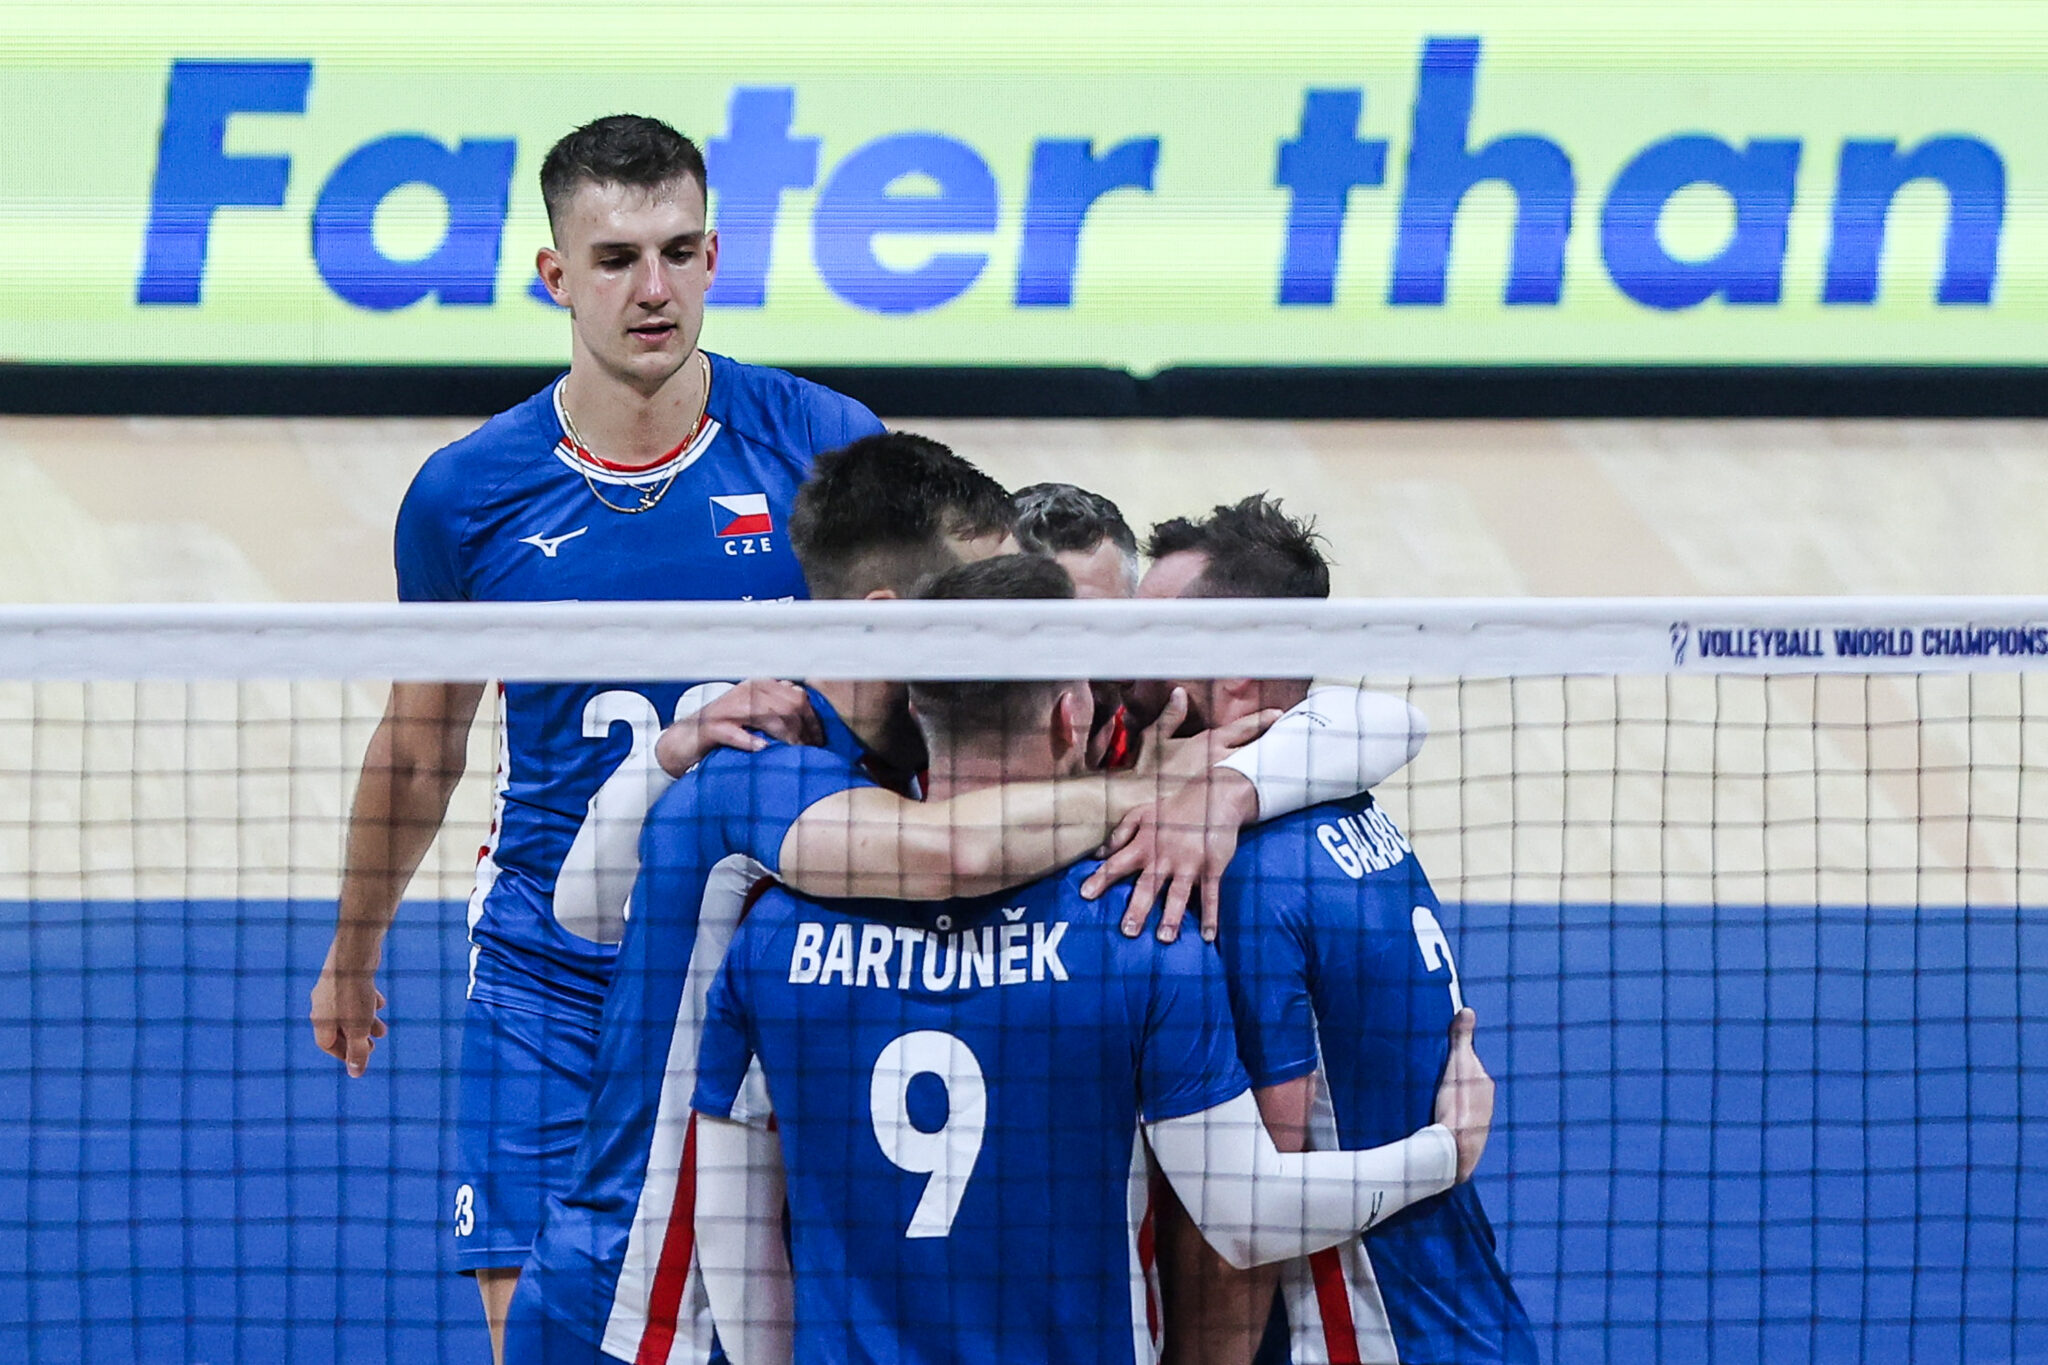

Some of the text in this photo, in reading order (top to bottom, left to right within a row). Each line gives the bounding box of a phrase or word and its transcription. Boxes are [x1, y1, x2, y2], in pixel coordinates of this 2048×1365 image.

[136, 35, 2006, 313] Fater than
[724, 537, 773, 556] CZE
[1698, 628, 1824, 658] VOLLEYBALL
[1833, 628, 1914, 657] WORLD
[788, 906, 1070, 992] BARTŮNĚK
[870, 1030, 988, 1239] 9
